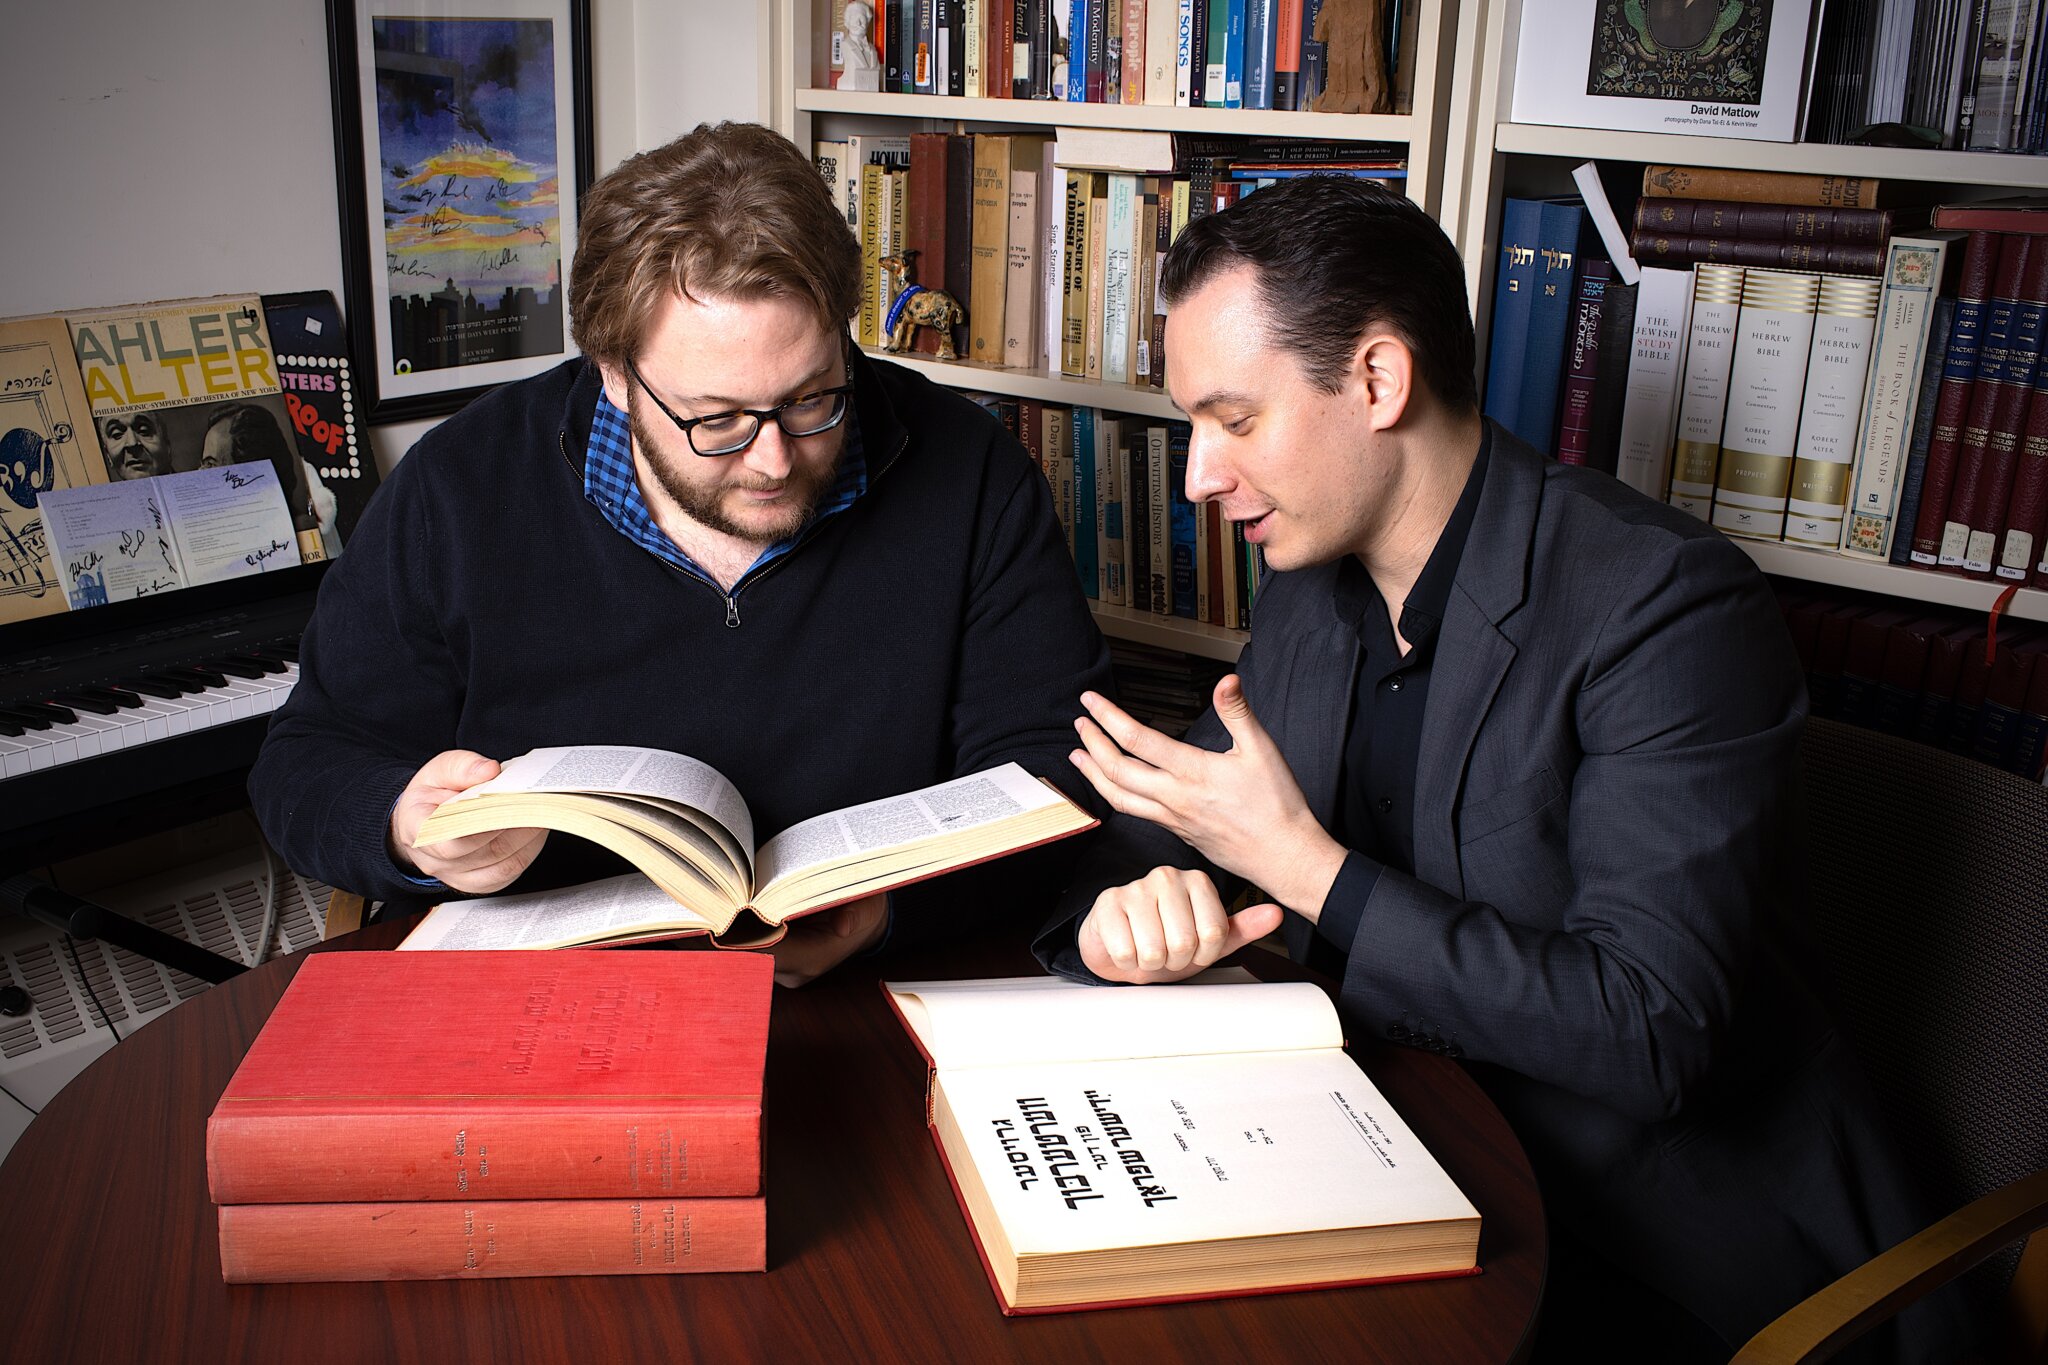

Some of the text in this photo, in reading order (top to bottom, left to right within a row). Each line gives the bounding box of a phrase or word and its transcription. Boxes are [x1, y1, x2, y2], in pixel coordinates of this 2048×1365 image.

[1089, 7, 1100, 64] Modernity
[1178, 16, 1190, 67] SONGS
[1126, 22, 1141, 71] people
[1660, 84, 1685, 98] 1915
[1691, 105, 1760, 118] David Matlow
[1664, 116, 1692, 124] photography
[816, 156, 837, 166] WORLD
[823, 166, 836, 174] OUR
[893, 188, 902, 228] BINTEL
[1064, 180, 1078, 297] YIDDISH POETRY
[1074, 200, 1084, 292] A TREASURY OF
[864, 172, 878, 336] THE GOLDEN TRADITION
[1050, 250, 1058, 286] Stranger
[1105, 249, 1118, 336] Modern Yiddish Verse
[1116, 249, 1128, 324] The Penguin Book
[1544, 284, 1556, 296] א
[880, 279, 888, 308] TERMS
[186, 304, 237, 316] MASTERWORKS
[1906, 302, 1914, 325] BIALIK
[2022, 312, 2040, 320] מסכת
[1646, 317, 1669, 327] THE
[483, 329, 499, 337] WERE
[500, 326, 521, 334] PURPLE
[1635, 327, 1678, 340] JEWISH
[1694, 324, 1732, 334] HEBREW
[1834, 326, 1850, 334] THE
[75, 312, 267, 366] AHLER
[1752, 332, 1792, 343] HEBREW
[1637, 338, 1674, 350] STUDY
[1698, 340, 1721, 348] BIBLE
[1820, 338, 1860, 350] HEBREW
[462, 350, 475, 358] ALEX
[1637, 350, 1670, 361] BIBLE
[1757, 348, 1781, 356] BIBLE
[1824, 354, 1850, 364] BIBLE
[2009, 366, 2030, 374] VOLUME
[86, 348, 277, 407] ALTER
[1750, 384, 1778, 392] Translation
[1878, 376, 1886, 398] SEFER
[190, 393, 230, 402] ORCHESTRA
[241, 389, 258, 397] NEW
[260, 386, 279, 394] YORK
[1688, 392, 1718, 400] Commentary
[1817, 392, 1846, 400] Translation
[1745, 402, 1777, 410] Commentary
[1022, 405, 1029, 420] MY
[1813, 409, 1845, 419] Commentary
[1878, 344, 1909, 484] THE BOOK of LEGENDS
[283, 392, 344, 455] ROOF
[1686, 416, 1712, 424] ROBERT
[1050, 414, 1059, 457] A Day in
[1688, 426, 1708, 434] ALTER
[1744, 426, 1771, 436] ROBERT
[1994, 430, 2017, 440] HEBREW
[1746, 437, 1767, 446] ALTER
[1811, 434, 1839, 444] ROBERT
[1812, 445, 1834, 454] ALTER
[1074, 421, 1082, 524] Literature of Destruction
[1152, 438, 1164, 548] OUTWITTING HISTORY
[991, 1118, 1040, 1190] גרויסער
[1086, 1146, 1108, 1170] דער
